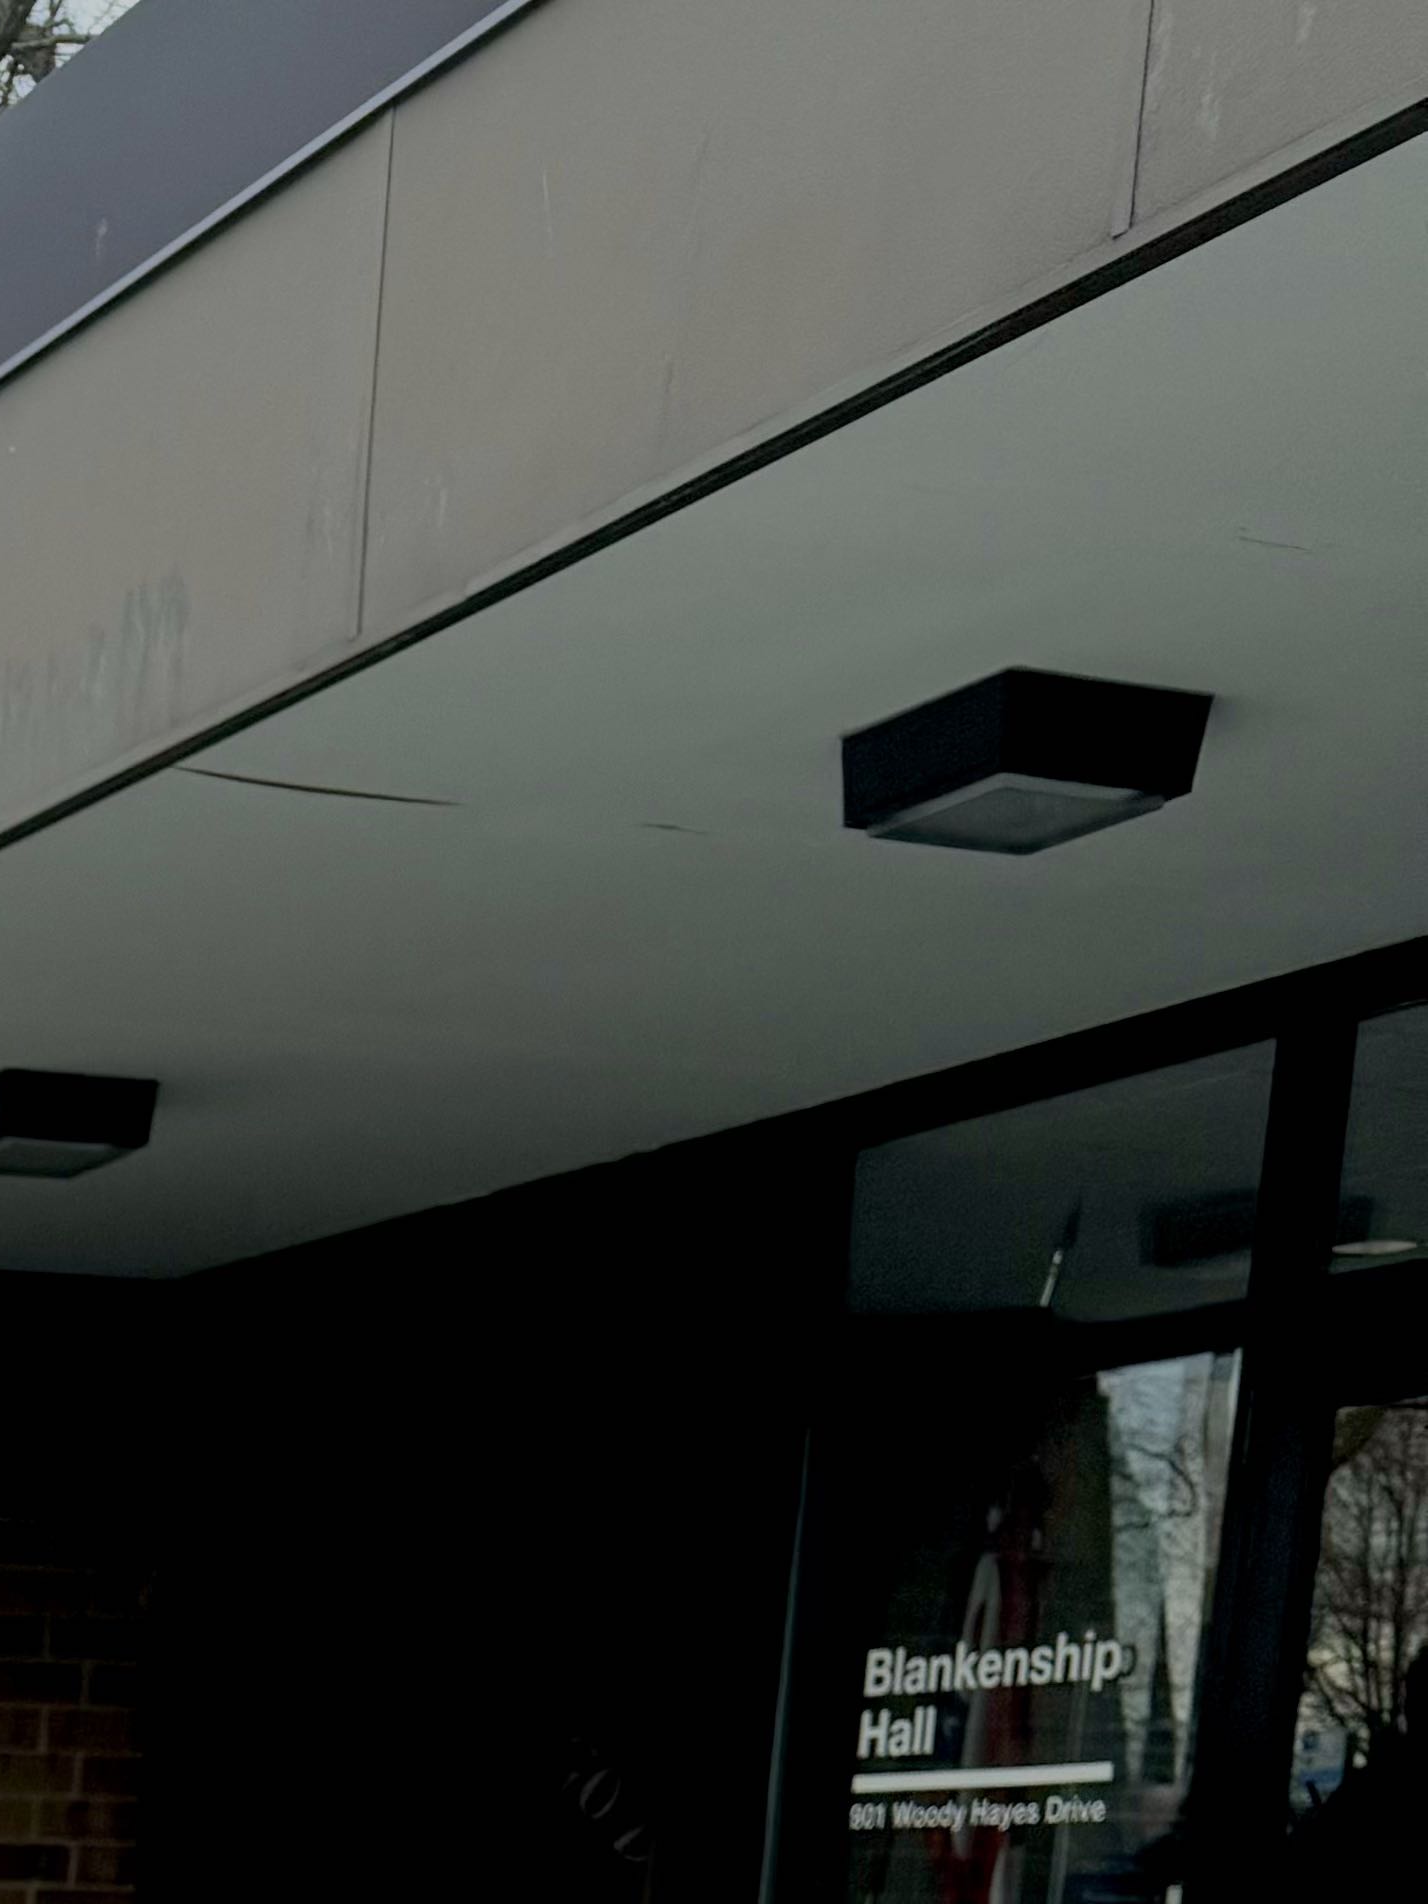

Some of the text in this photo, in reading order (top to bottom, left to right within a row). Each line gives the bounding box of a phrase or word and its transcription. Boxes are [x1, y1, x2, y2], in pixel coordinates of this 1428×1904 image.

[863, 1629, 1124, 1698] Blankenship
[856, 1704, 938, 1760] Hall
[893, 1800, 964, 1832] Woody
[969, 1798, 1041, 1832] Hayes
[1043, 1795, 1107, 1824] Drive
